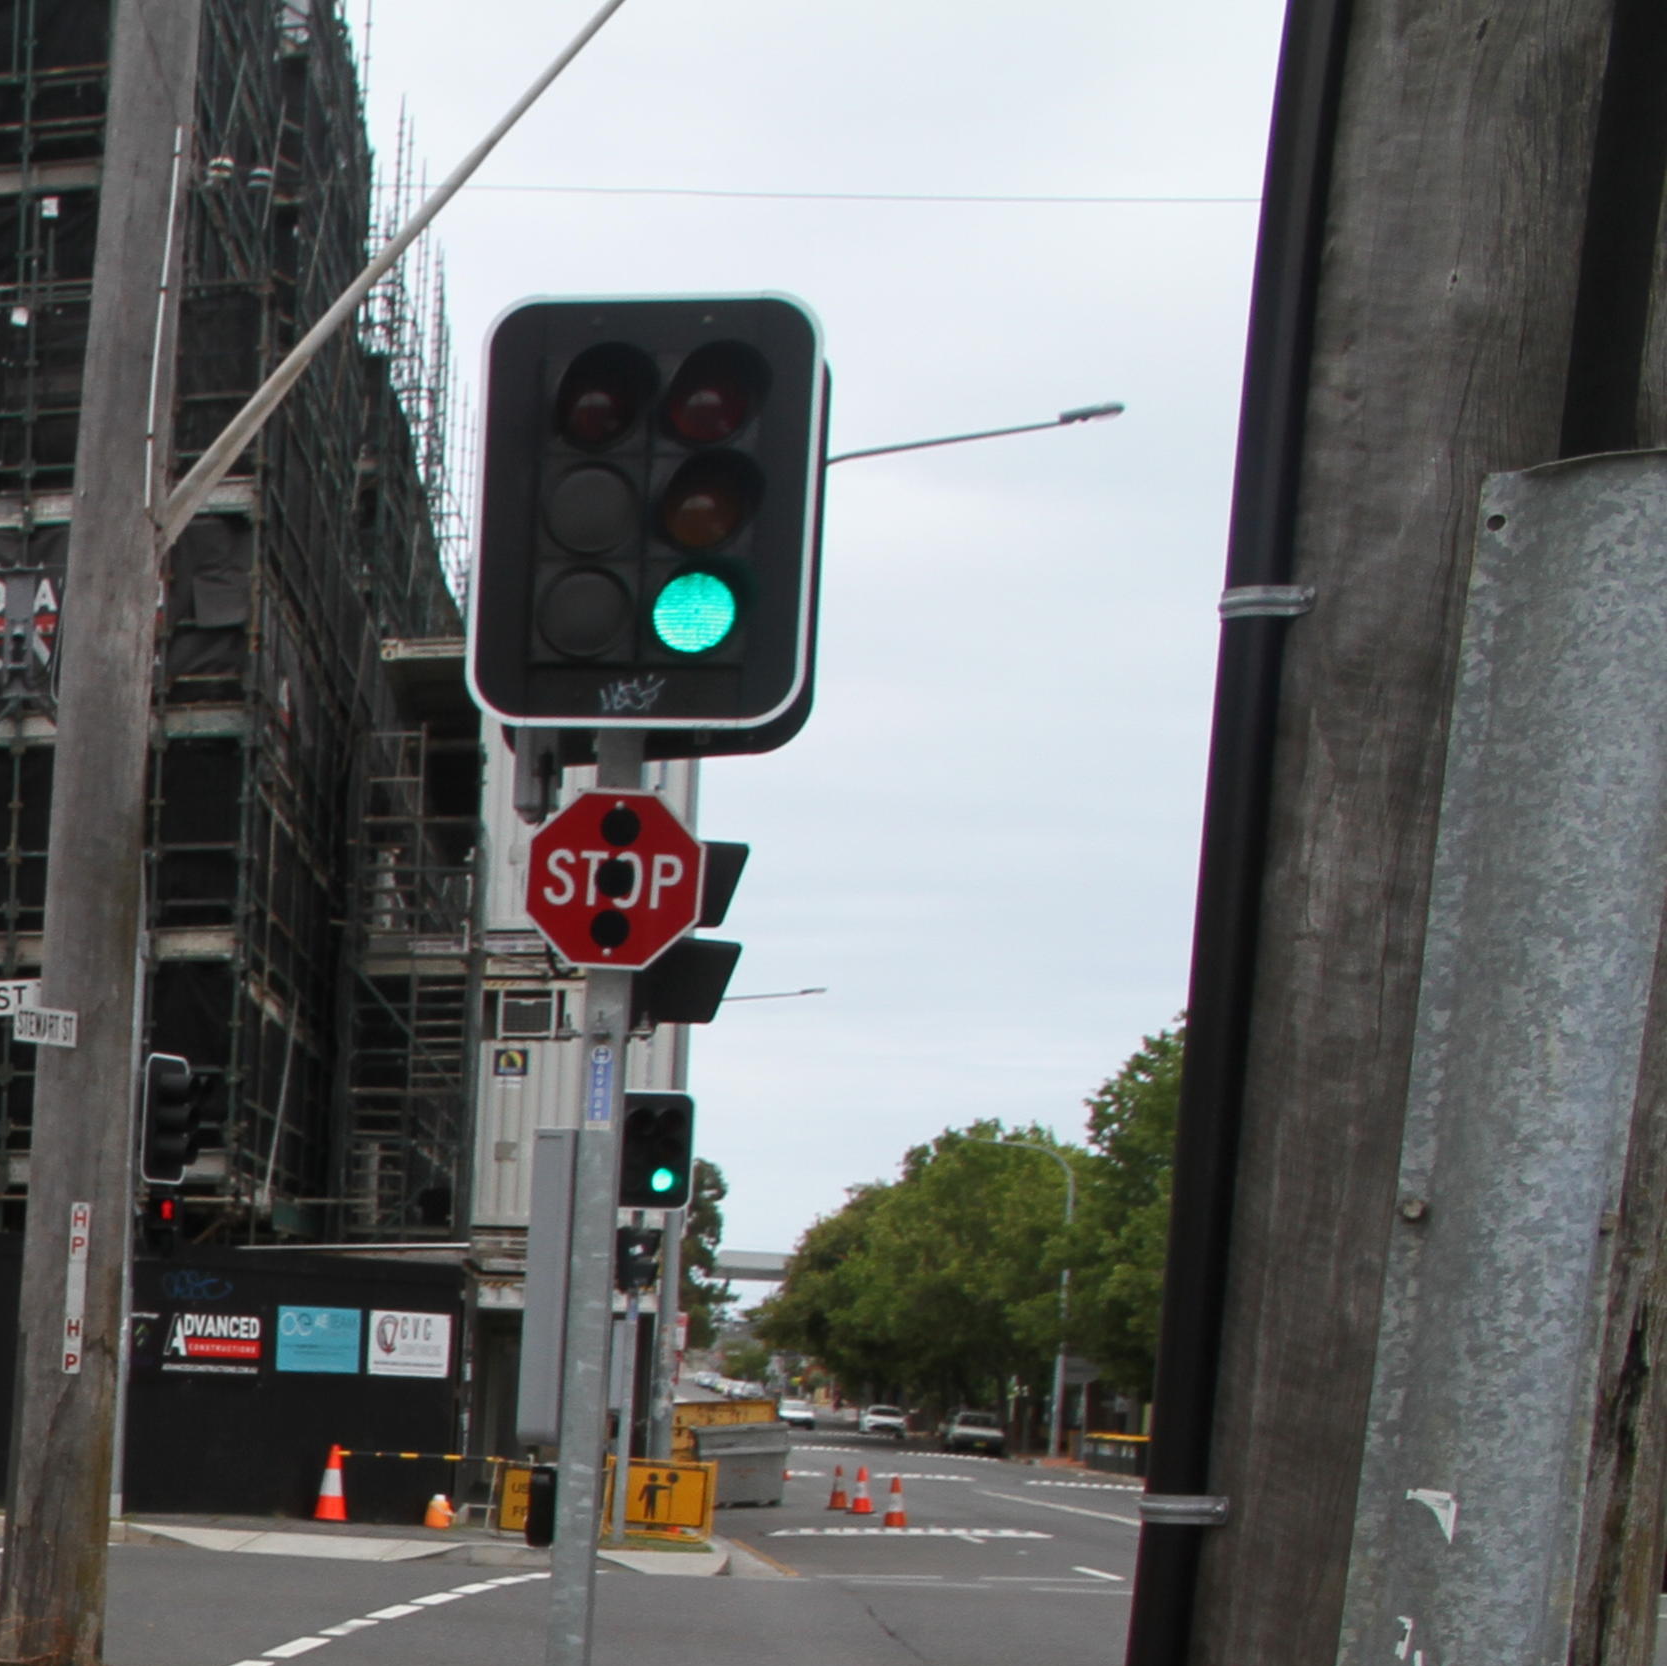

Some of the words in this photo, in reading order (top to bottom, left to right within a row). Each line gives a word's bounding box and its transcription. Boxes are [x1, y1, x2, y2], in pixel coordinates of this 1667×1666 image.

[543, 848, 684, 910] STOP
[62, 1016, 74, 1042] ST
[163, 1313, 260, 1356] ADVANCED
